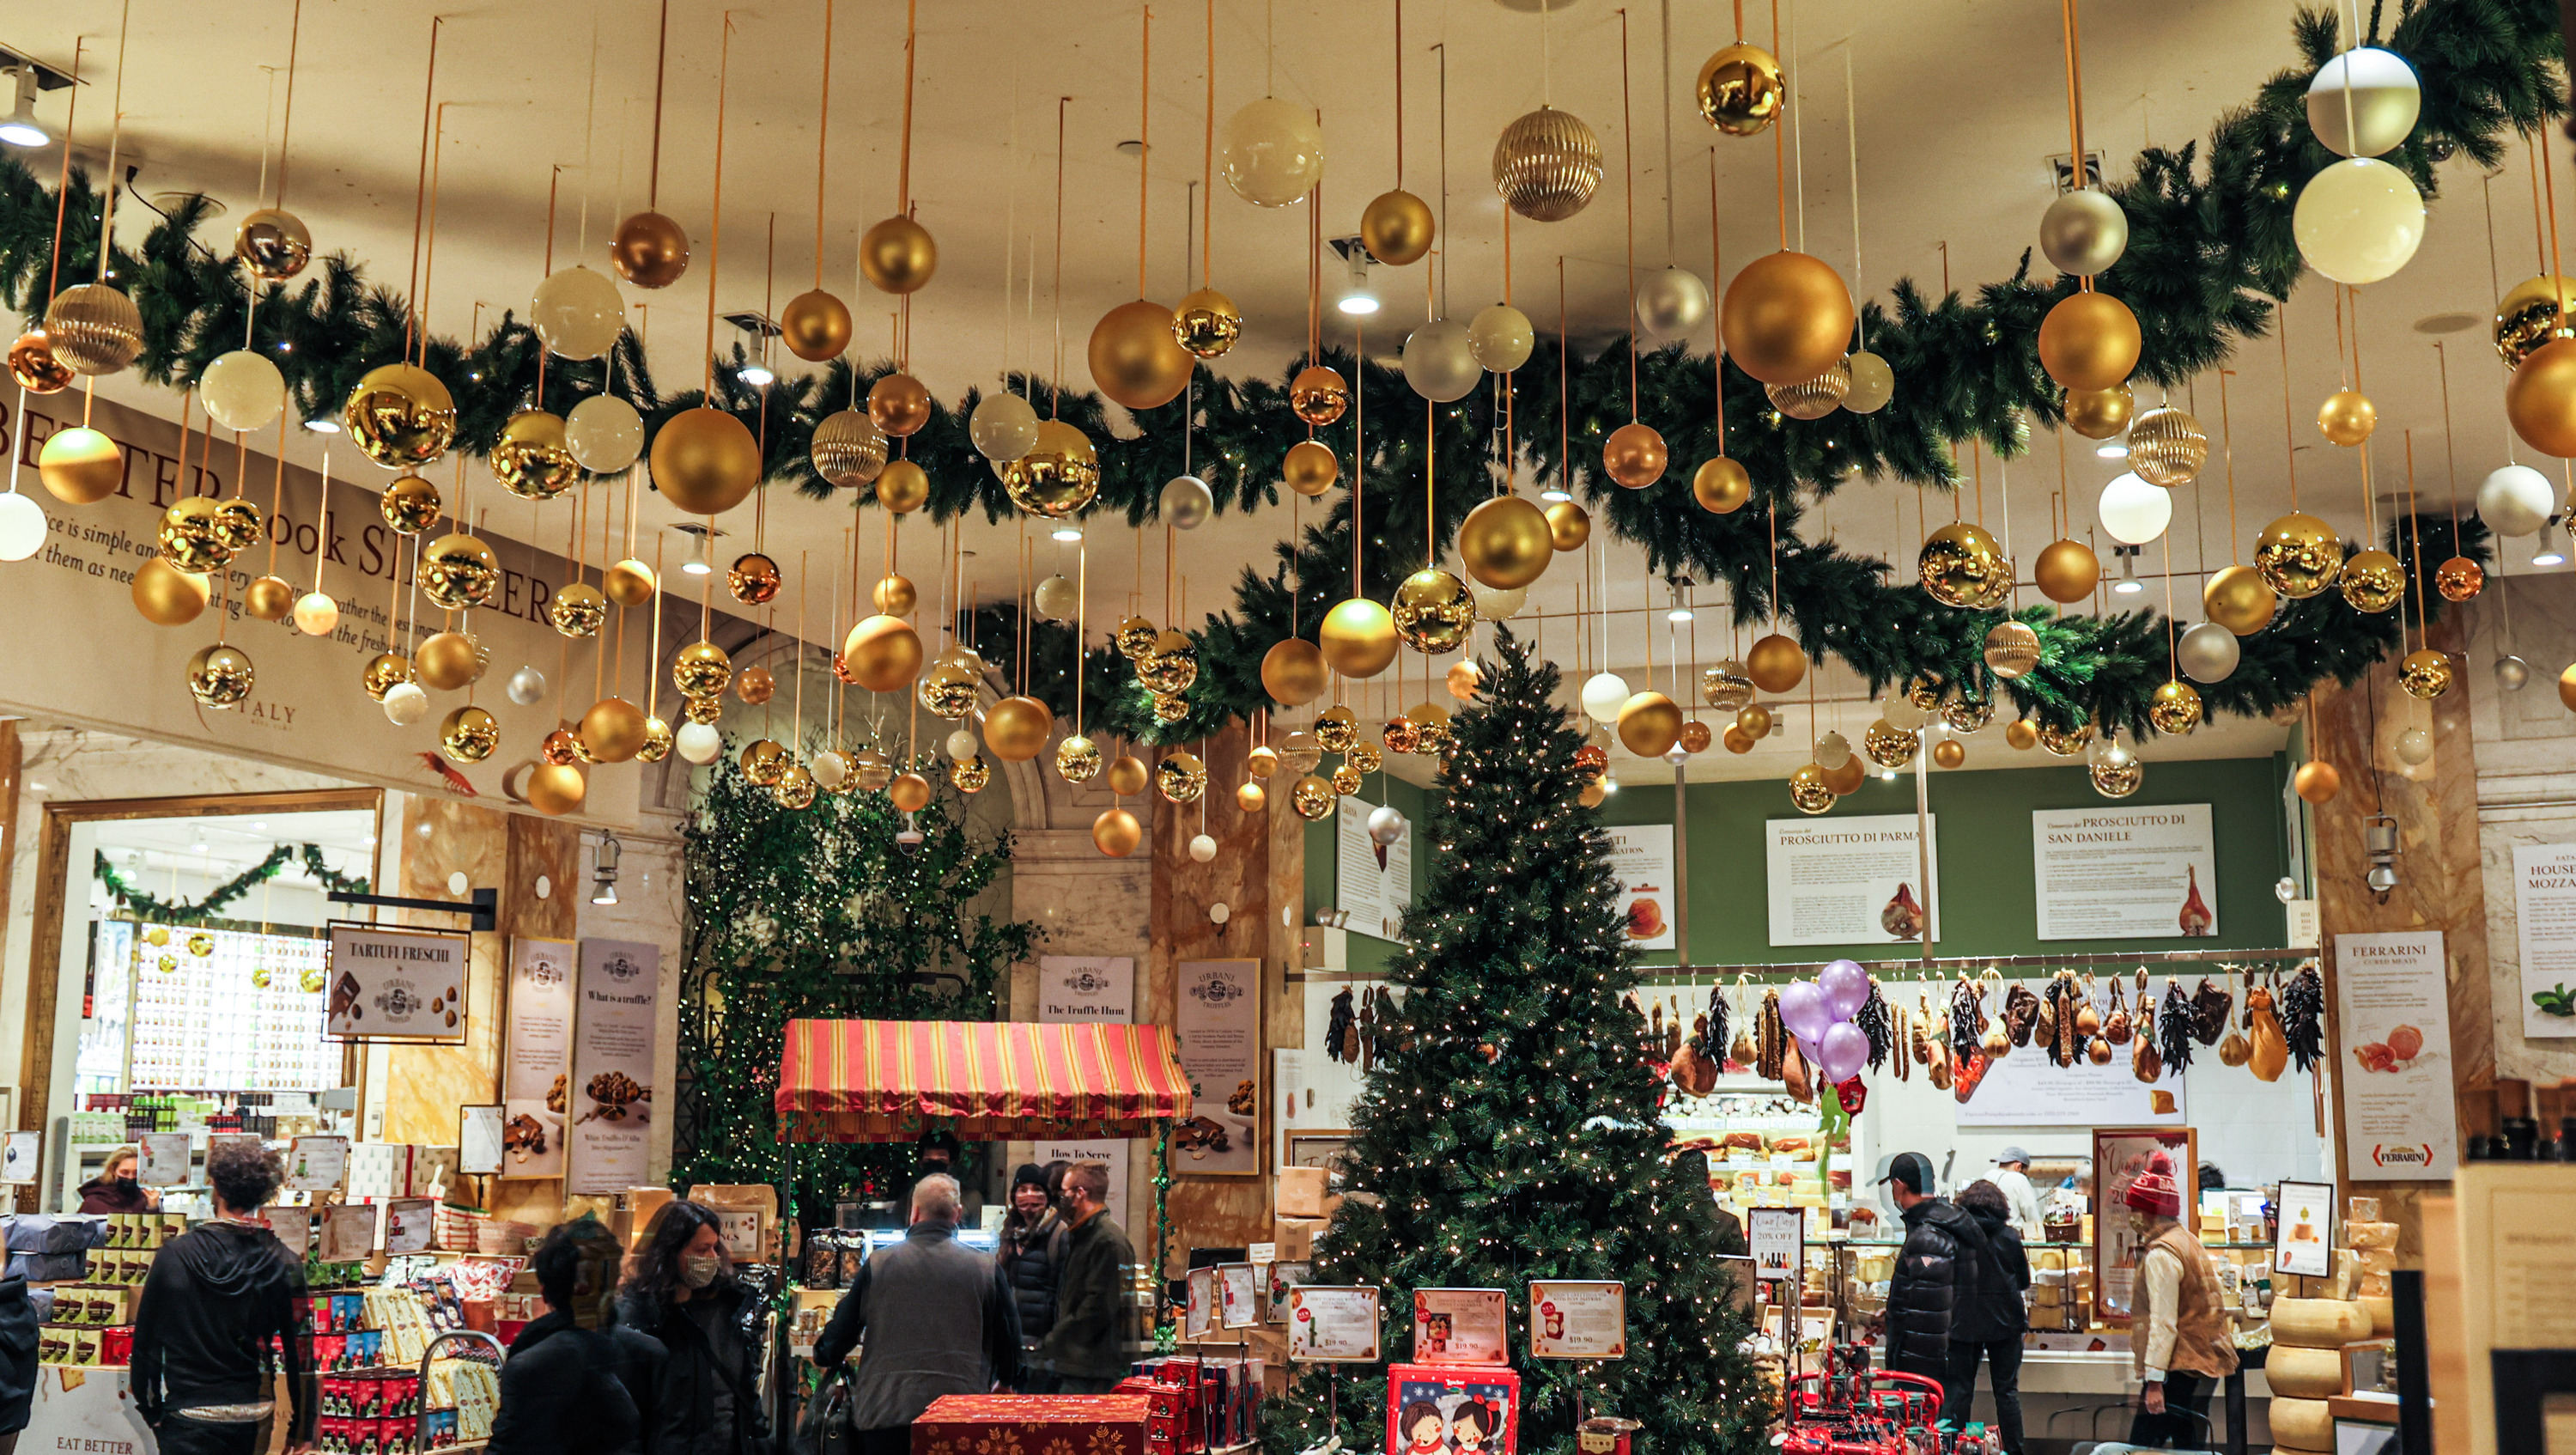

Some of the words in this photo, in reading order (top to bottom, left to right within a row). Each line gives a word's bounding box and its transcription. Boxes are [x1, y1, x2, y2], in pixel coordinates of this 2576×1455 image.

[0, 401, 221, 510] ETER
[267, 510, 346, 566] ook
[68, 518, 80, 537] is
[82, 524, 132, 556] simple
[46, 544, 82, 572] them
[88, 561, 106, 577] as
[109, 567, 135, 586] nee
[335, 597, 368, 618] ather
[371, 605, 387, 626] the
[337, 624, 357, 645] the
[2082, 814, 2167, 829] PROSCIUTTO
[2172, 814, 2185, 825] DI
[1780, 833, 1861, 846] PROSCIUTTO
[1864, 832, 1877, 843] DI
[1880, 831, 1920, 842] PARMA
[2048, 833, 2072, 844] SAN
[2076, 831, 2132, 843] DANIELE
[349, 942, 398, 959] TARTUFI
[403, 946, 449, 963] FRESCHI
[2353, 945, 2427, 957] FERRARINI
[1071, 966, 1103, 976] URBANI
[1199, 971, 1236, 983] URBANI
[587, 989, 608, 1001] What
[610, 993, 617, 1003] is
[623, 994, 651, 1006] truffle?
[1203, 1001, 1231, 1009] TRUFFLES
[1047, 1005, 1064, 1014] The
[1066, 1005, 1098, 1015] Truffle
[1101, 1006, 1124, 1015] Hunt
[1051, 1148, 1071, 1159] How
[1074, 1149, 1084, 1160] To
[1086, 1151, 1111, 1160] Serve
[2381, 1153, 2425, 1162] FERRARINI
[57, 1437, 81, 1450] EAT
[84, 1439, 133, 1455] BETTER
